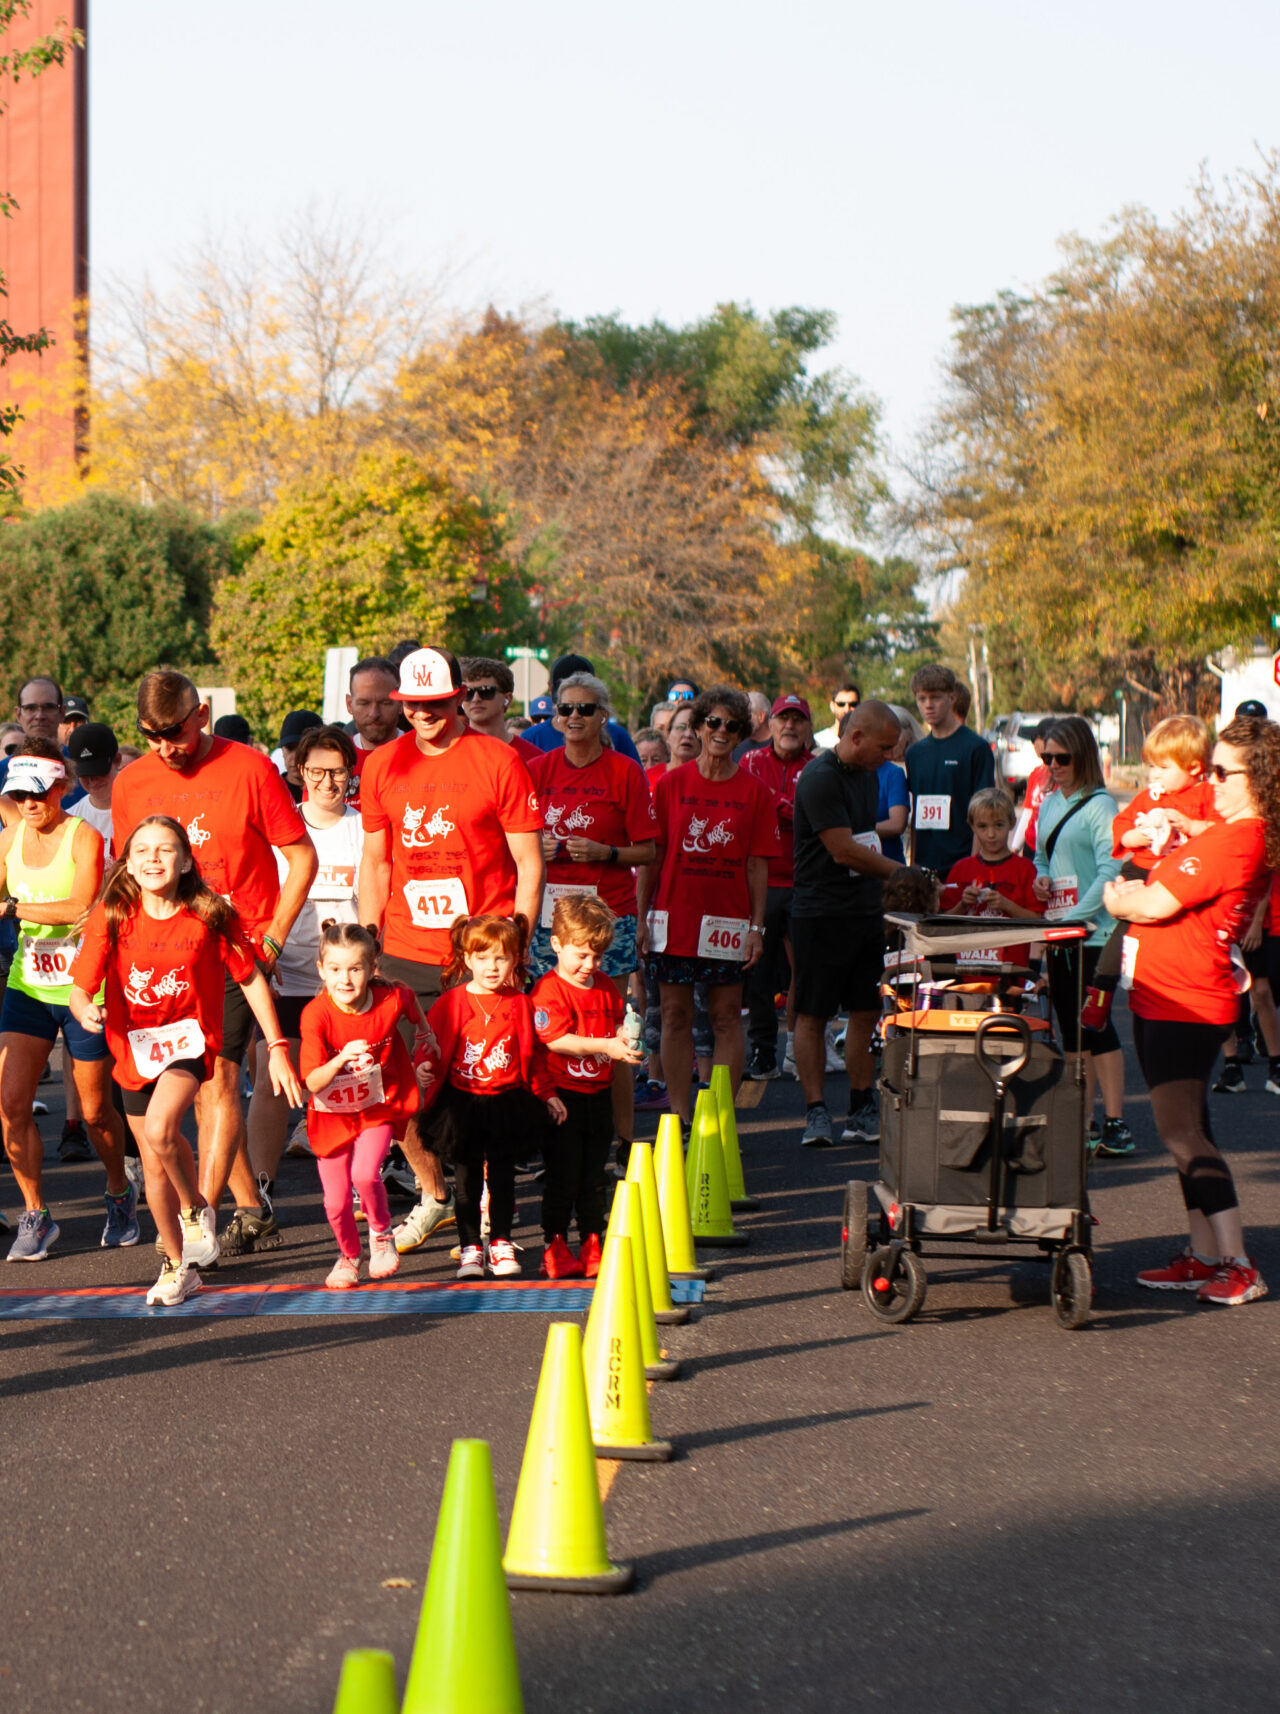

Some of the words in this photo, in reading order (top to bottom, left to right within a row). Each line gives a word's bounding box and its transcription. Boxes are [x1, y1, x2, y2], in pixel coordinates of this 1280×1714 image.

[412, 664, 433, 687] UM
[922, 805, 942, 820] 391
[315, 872, 349, 887] ALK
[417, 895, 455, 916] 412
[1048, 894, 1075, 909] WALK
[707, 929, 742, 950] 406
[31, 952, 67, 973] 380
[960, 949, 998, 961] WALK
[327, 1081, 370, 1104] 415
[604, 1337, 622, 1410] RCRM
